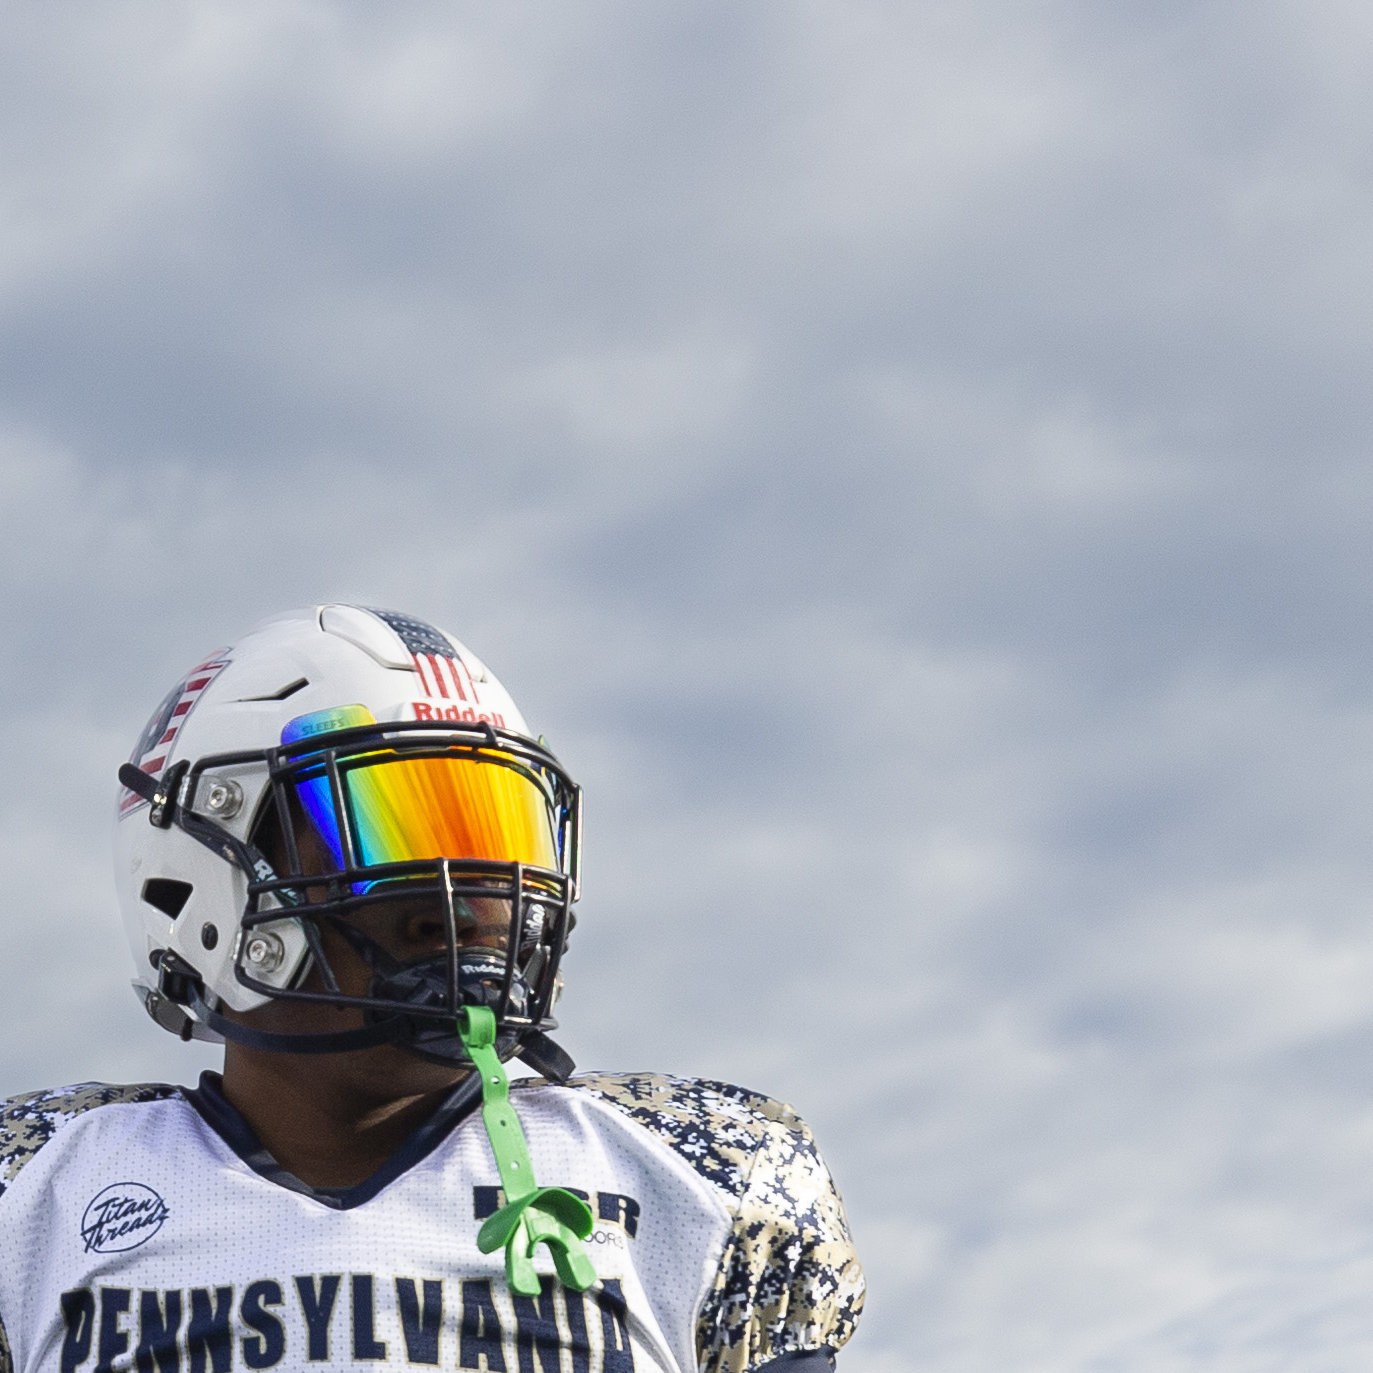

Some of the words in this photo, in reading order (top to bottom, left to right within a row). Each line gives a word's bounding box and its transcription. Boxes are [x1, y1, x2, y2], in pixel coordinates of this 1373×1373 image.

[301, 716, 346, 735] SLEEFS
[411, 702, 505, 730] Riddell
[95, 1197, 159, 1224] Titan
